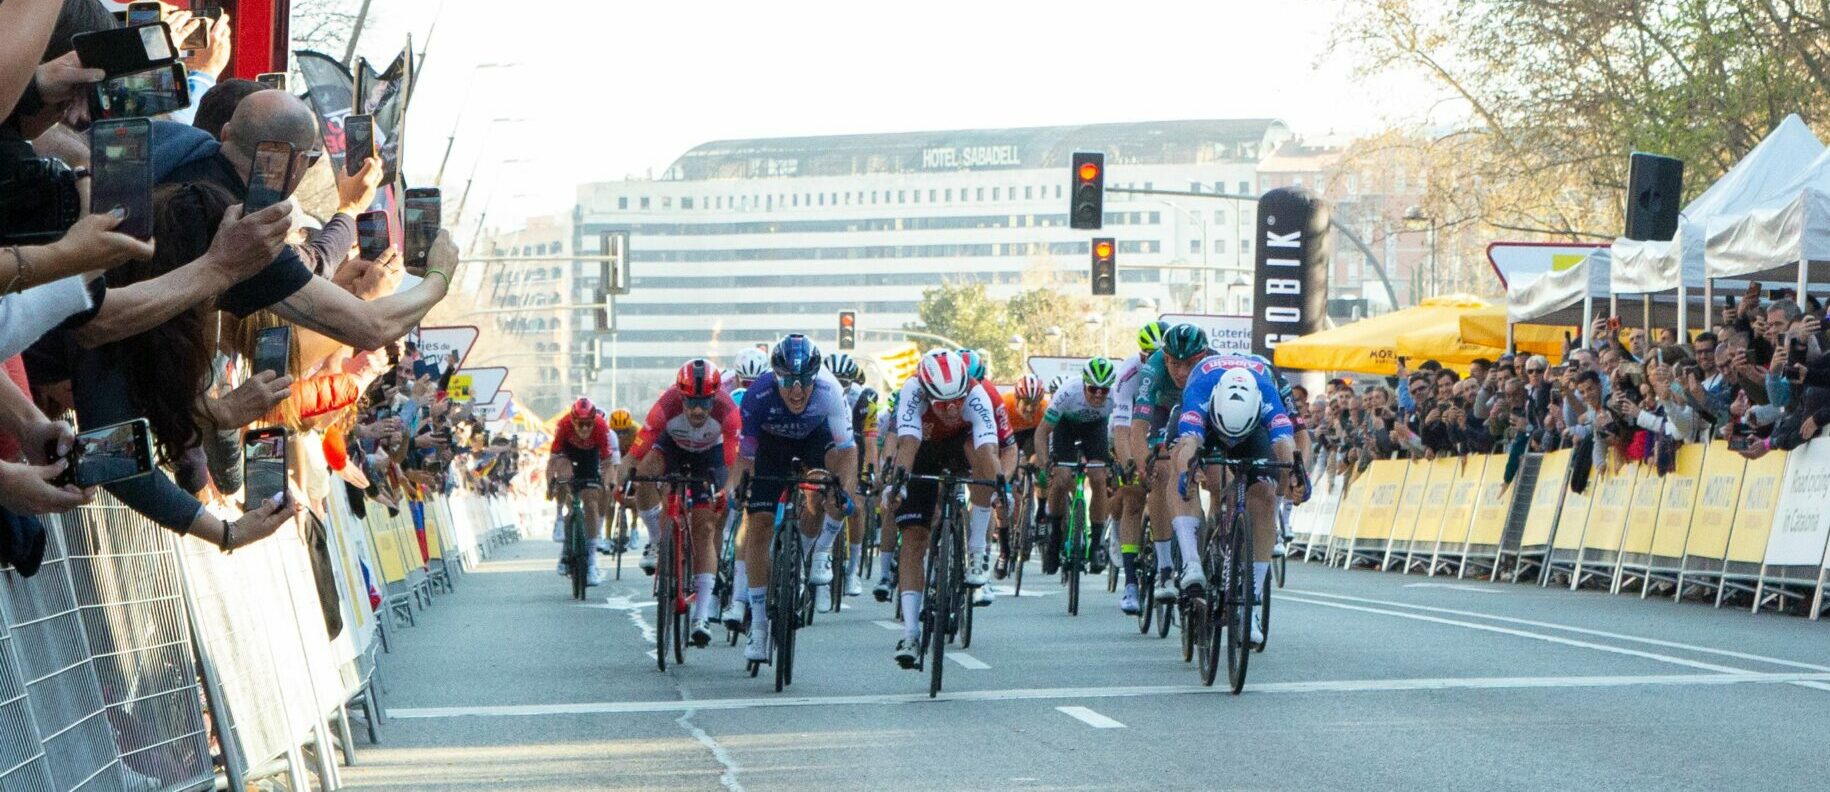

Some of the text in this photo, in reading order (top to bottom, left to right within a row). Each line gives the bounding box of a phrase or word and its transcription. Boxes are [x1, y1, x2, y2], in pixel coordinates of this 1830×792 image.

[922, 145, 1021, 168] HOTEL SABADELL
[1265, 230, 1302, 350] GOBIK
[1211, 338, 1251, 350] Catalu
[1369, 349, 1397, 360] MOR
